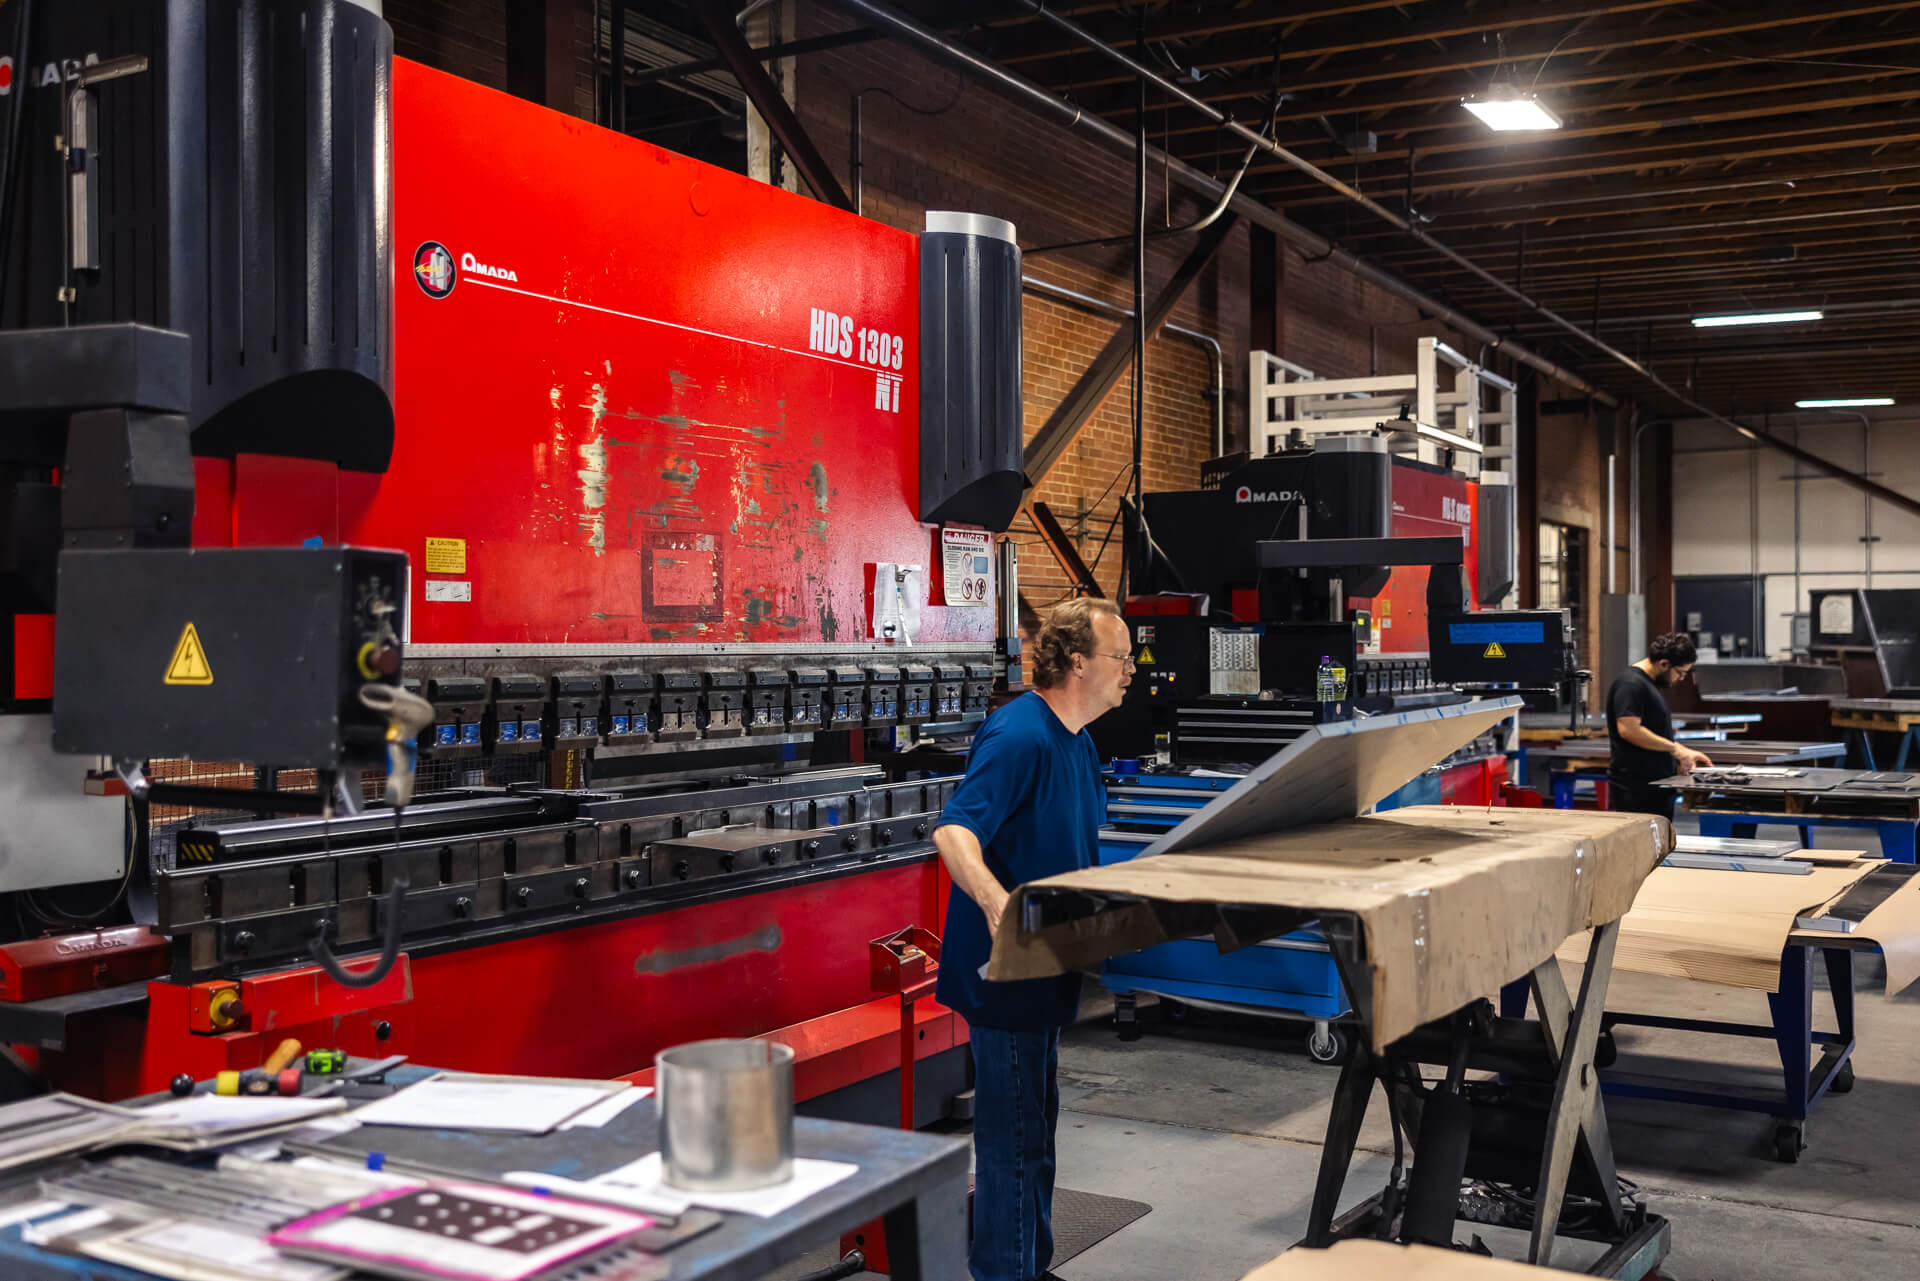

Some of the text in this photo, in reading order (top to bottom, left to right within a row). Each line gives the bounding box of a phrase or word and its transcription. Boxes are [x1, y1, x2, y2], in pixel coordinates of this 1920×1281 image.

[0, 53, 99, 95] AAD
[461, 252, 518, 282] AMADA
[809, 307, 903, 370] HDS 1303
